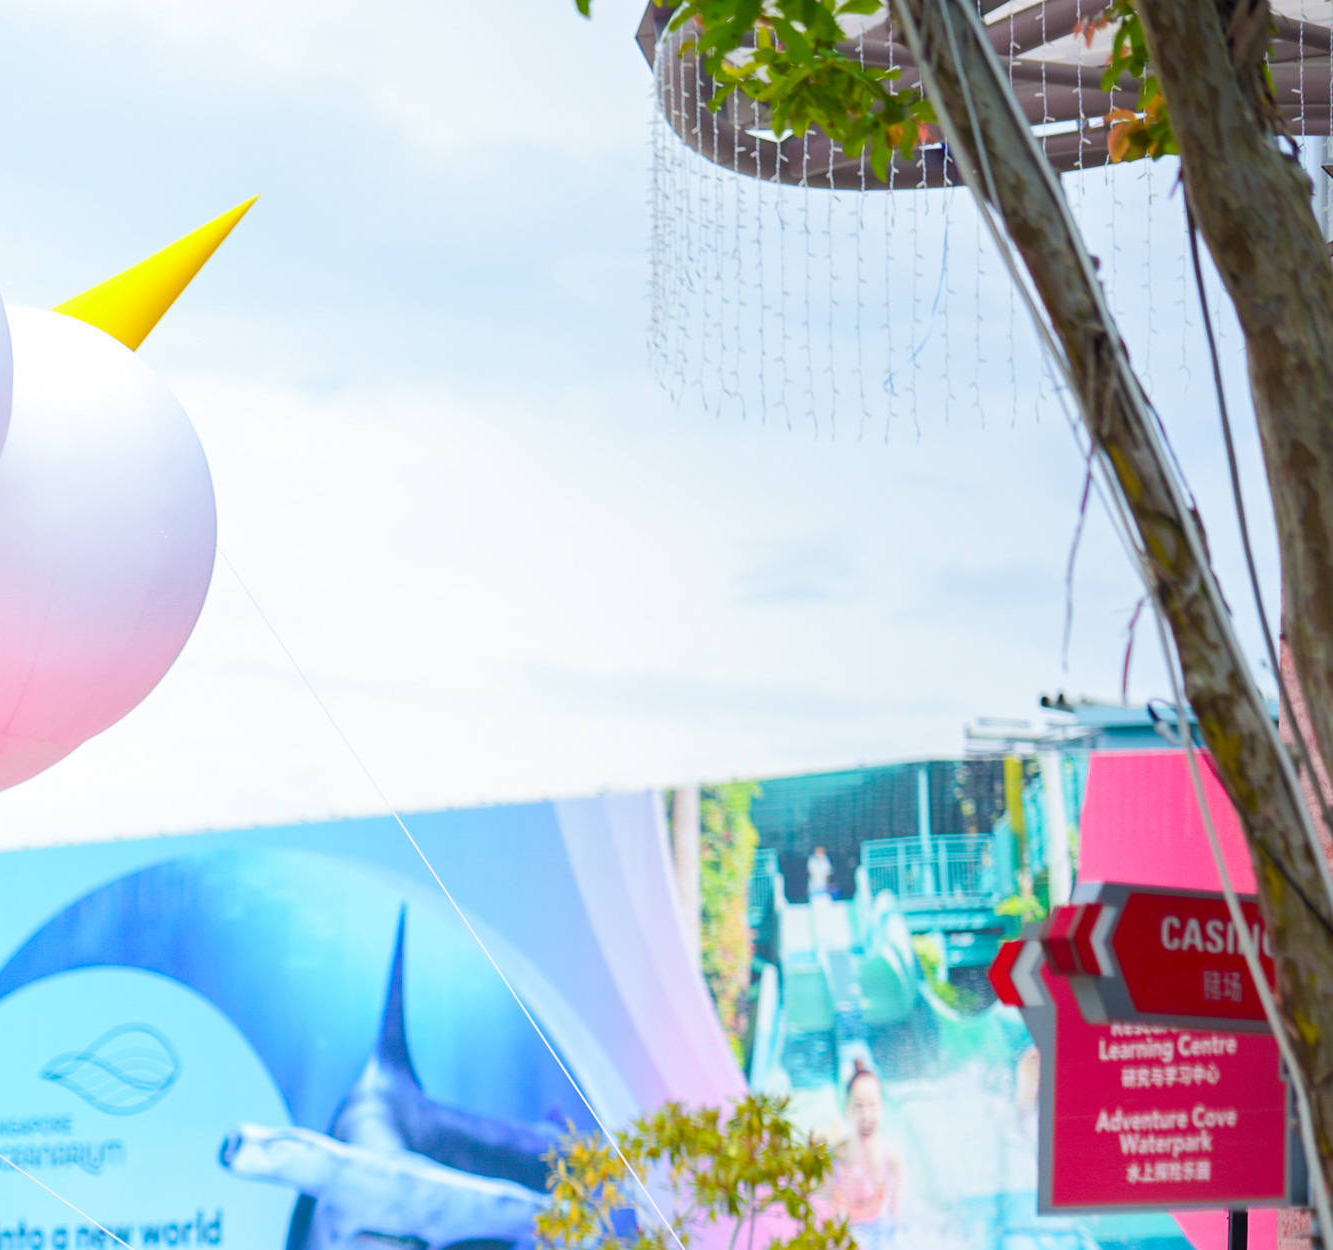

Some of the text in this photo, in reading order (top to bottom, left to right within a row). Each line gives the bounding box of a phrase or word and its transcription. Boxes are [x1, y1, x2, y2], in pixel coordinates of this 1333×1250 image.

[1098, 1033, 1238, 1063] Learning Centre
[1095, 1104, 1238, 1133] Adventure Cove
[1118, 1130, 1213, 1158] Waterpark
[75, 1225, 132, 1250] new
[139, 1206, 223, 1249] world
